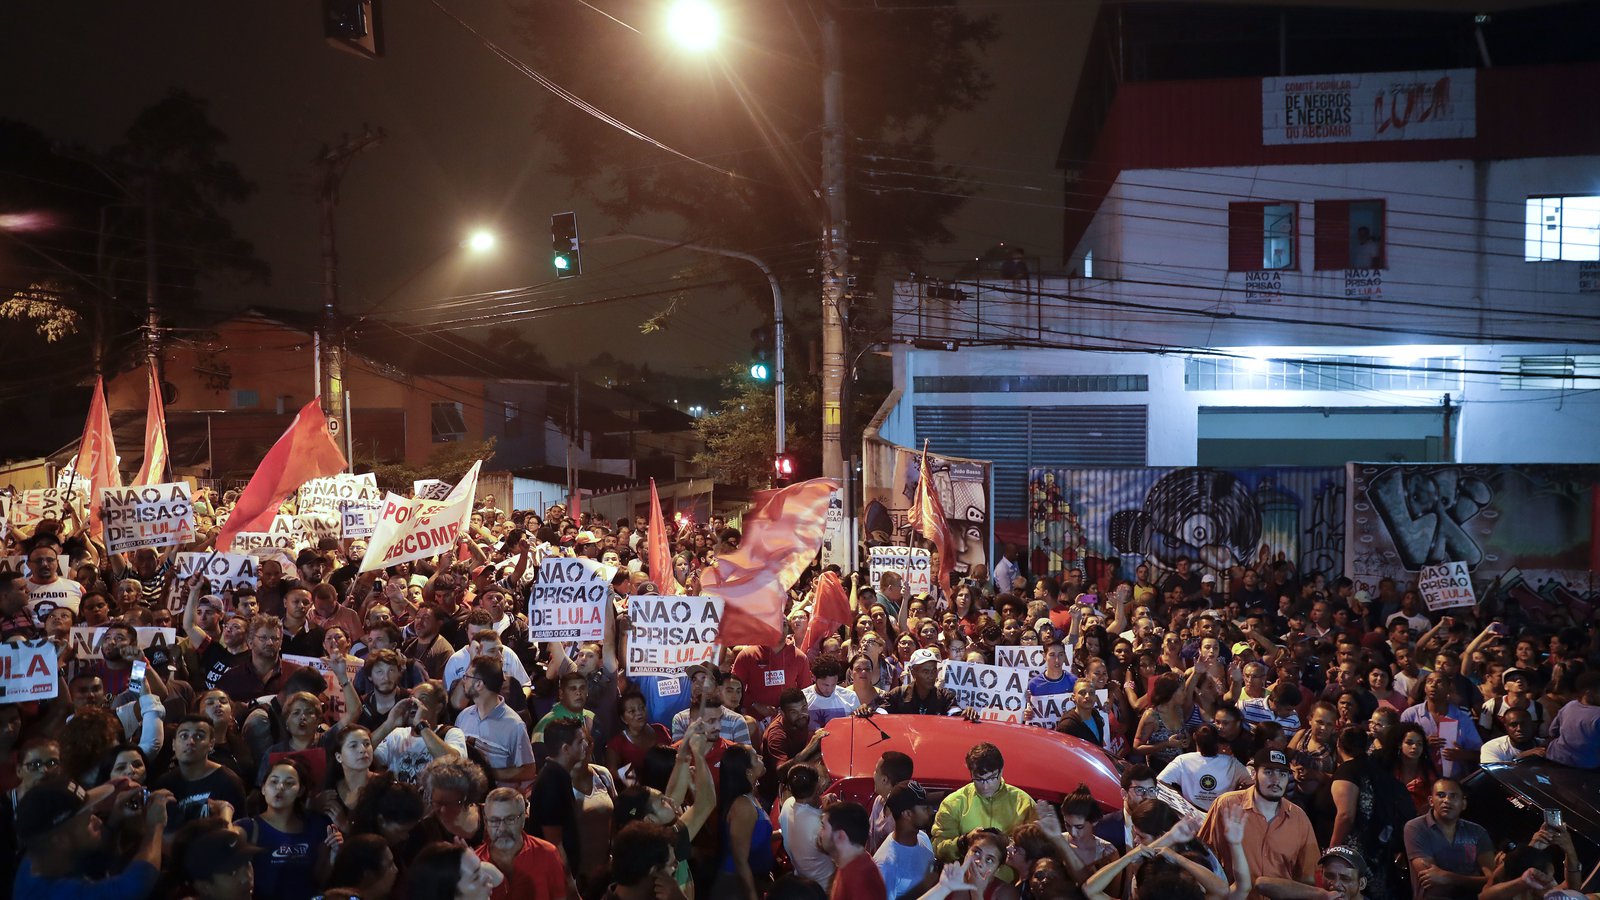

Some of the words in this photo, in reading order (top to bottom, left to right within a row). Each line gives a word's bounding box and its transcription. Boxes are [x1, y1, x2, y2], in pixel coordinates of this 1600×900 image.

[1285, 95, 1300, 110] DE
[1303, 93, 1351, 109] NEGROS
[1286, 110, 1294, 126] E
[1298, 108, 1352, 125] NEGRAS
[1286, 126, 1299, 139] DO
[1345, 288, 1356, 296] DE
[1358, 287, 1382, 295] LULA
[345, 514, 364, 526] DE
[108, 526, 134, 541] DE
[140, 518, 191, 537] LULA
[1425, 592, 1441, 603] DE
[1441, 588, 1472, 599] LULA
[531, 609, 552, 626] DE
[557, 606, 602, 625] LULA
[631, 623, 719, 645] PRISÃO
[630, 648, 657, 664] DE
[664, 645, 713, 664] LULA
[945, 662, 999, 690] NÃO
